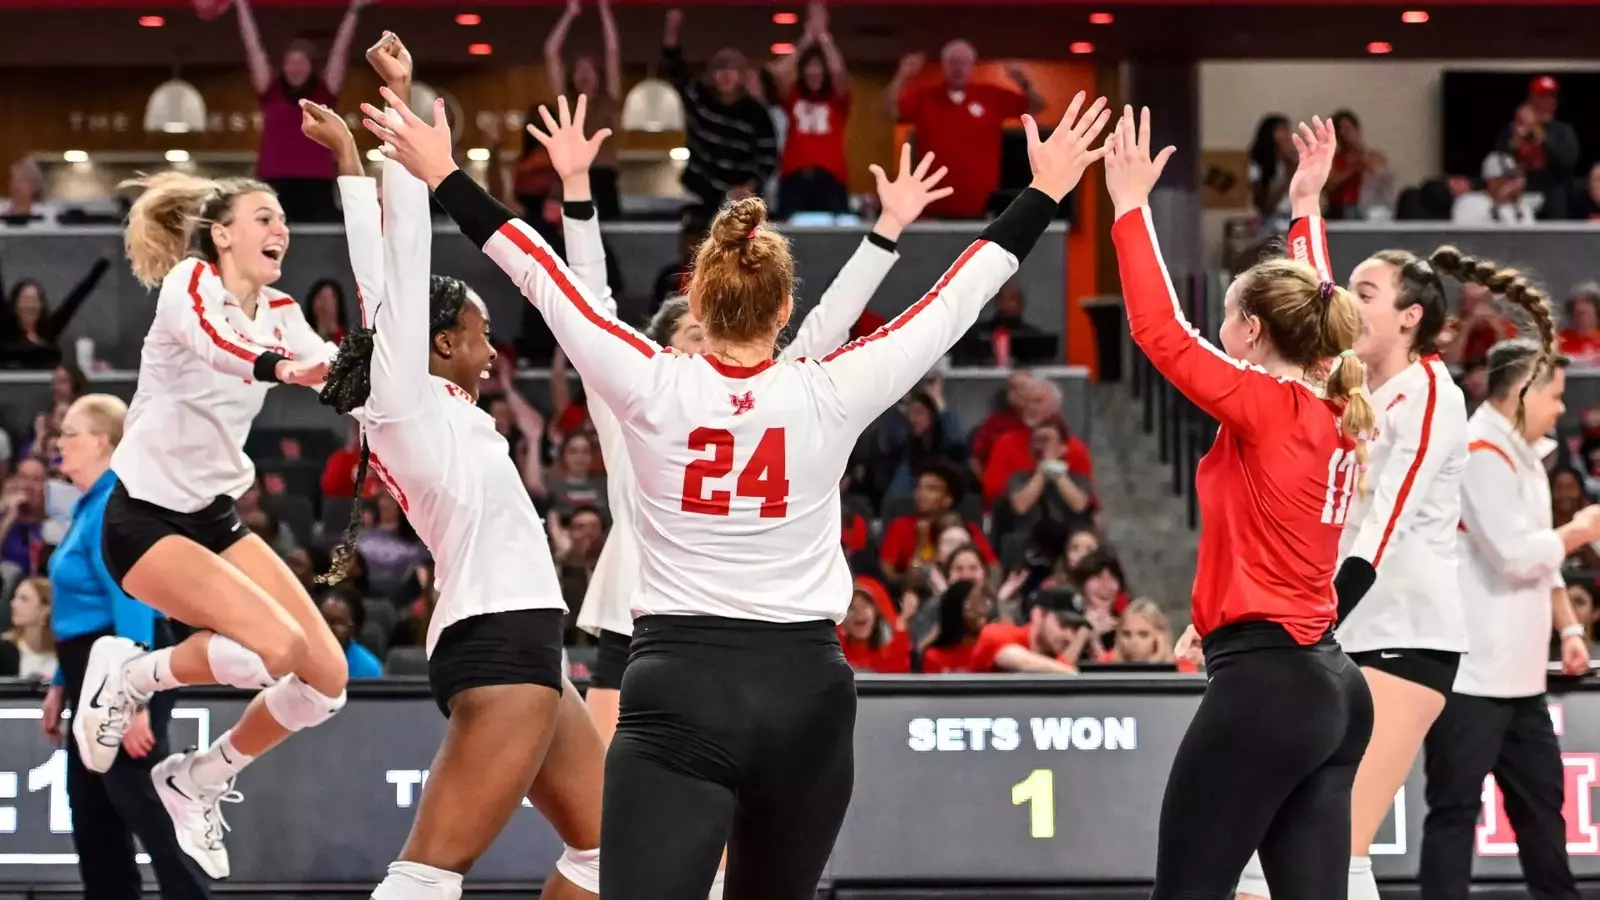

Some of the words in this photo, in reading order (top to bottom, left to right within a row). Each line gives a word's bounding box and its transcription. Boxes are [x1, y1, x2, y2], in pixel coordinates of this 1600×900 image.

[681, 427, 789, 518] 24
[908, 717, 1021, 751] SETS
[1030, 716, 1137, 750] WON
[1012, 768, 1054, 838] 1
